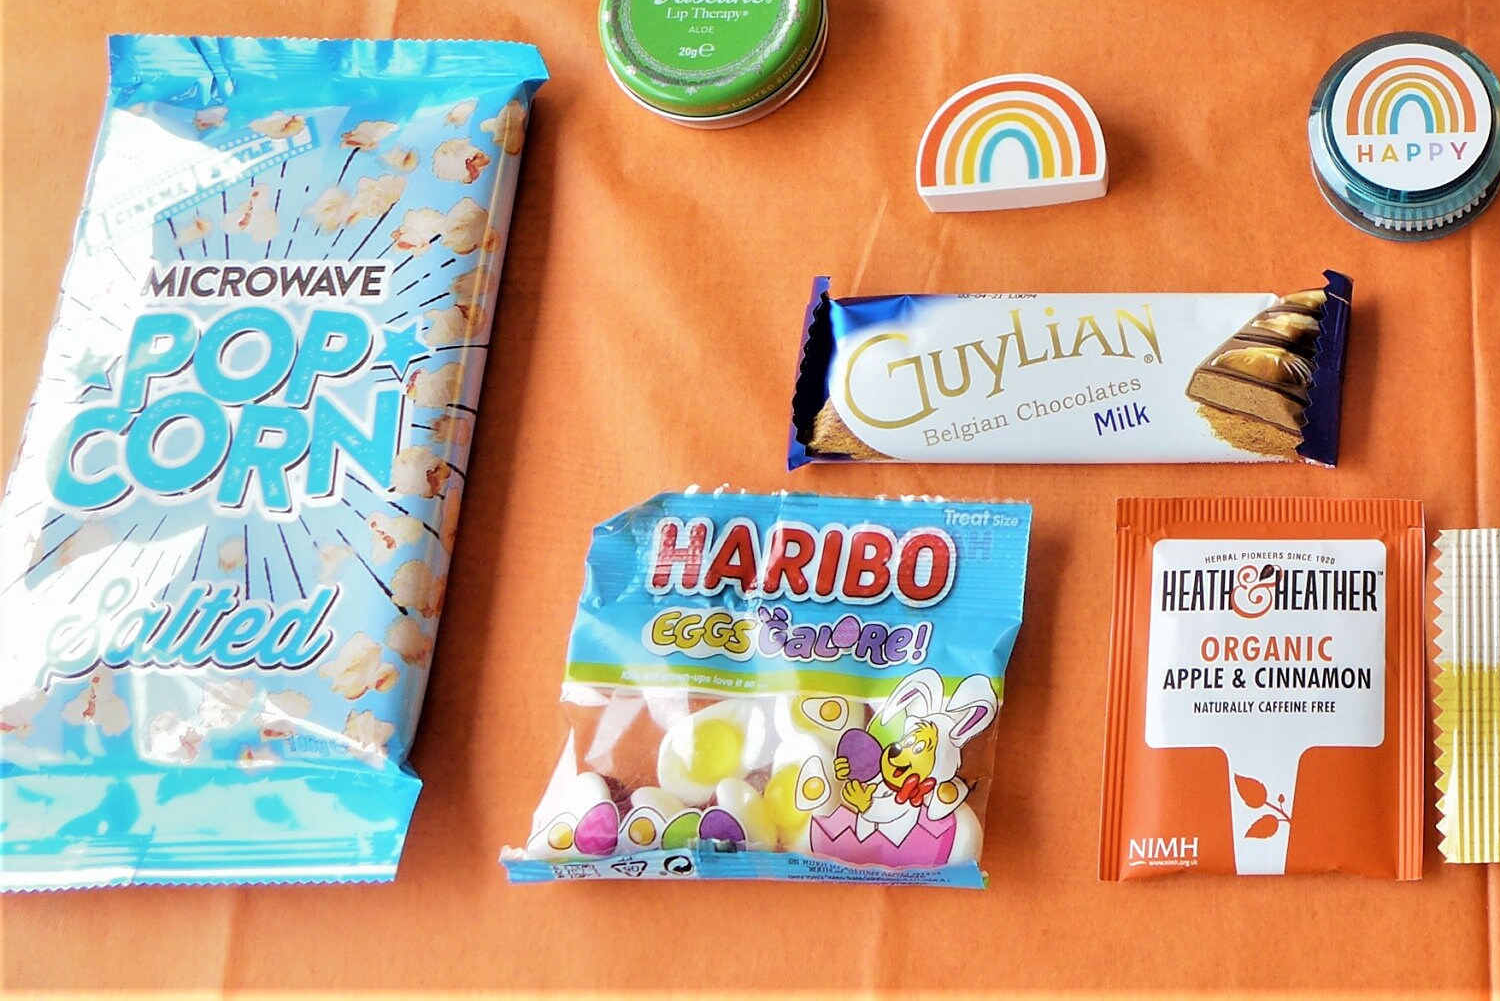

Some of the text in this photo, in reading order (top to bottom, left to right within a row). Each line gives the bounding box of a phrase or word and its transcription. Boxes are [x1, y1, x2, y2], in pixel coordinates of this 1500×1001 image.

[666, 7, 688, 21] Lip
[688, 25, 715, 34] ALOE
[1357, 141, 1468, 163] HAPPY
[143, 265, 387, 298] MICROWAVE
[126, 306, 376, 410] POP
[922, 377, 1142, 448] Belgian Chocolates
[1092, 403, 1151, 437] Milk
[46, 389, 404, 514] CORN
[944, 508, 1019, 527] Treat Size
[650, 520, 951, 603] HARIBO
[1205, 552, 1336, 565] HERBAL PIONEERS SINCE 1920
[40, 577, 339, 690] Salted
[651, 611, 755, 654] EGGS
[1200, 635, 1333, 662] ORGANIC
[713, 675, 733, 687] love
[1162, 667, 1372, 690] APPLE & CINNAMON
[1193, 701, 1336, 714] NATURALLY CAFFEINE FREE
[1128, 837, 1199, 859] NIMH
